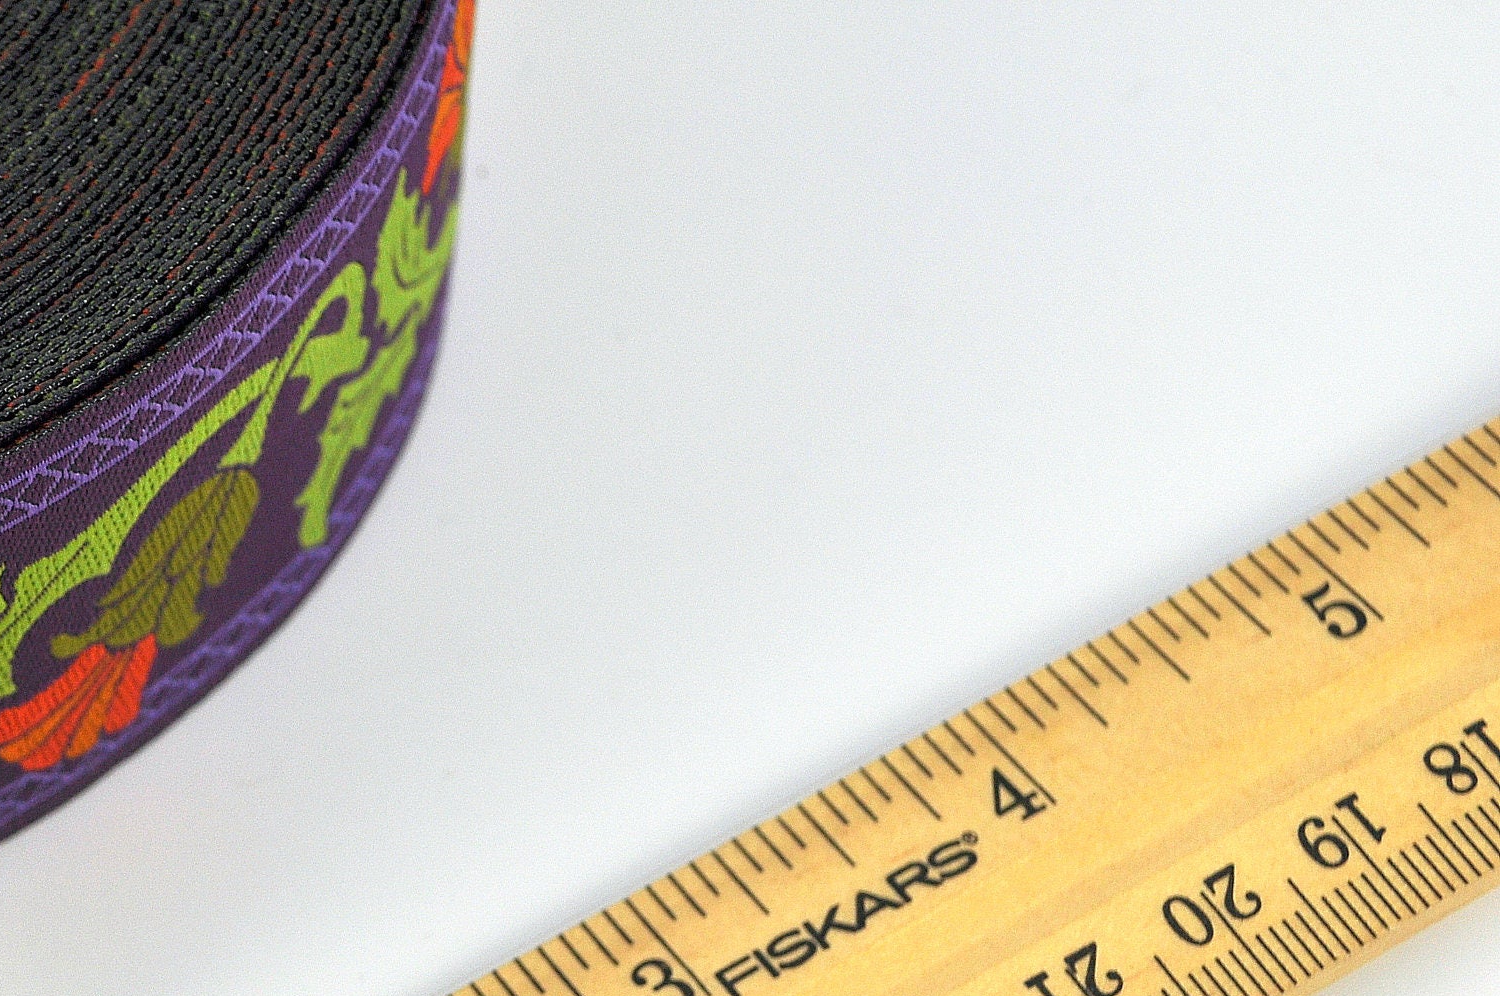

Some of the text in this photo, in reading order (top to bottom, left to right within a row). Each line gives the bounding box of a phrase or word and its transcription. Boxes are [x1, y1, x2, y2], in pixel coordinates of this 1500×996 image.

[992, 767, 1047, 820] 4
[1302, 581, 1367, 640] 5
[1297, 793, 1386, 869] 19
[1162, 863, 1262, 947] 20
